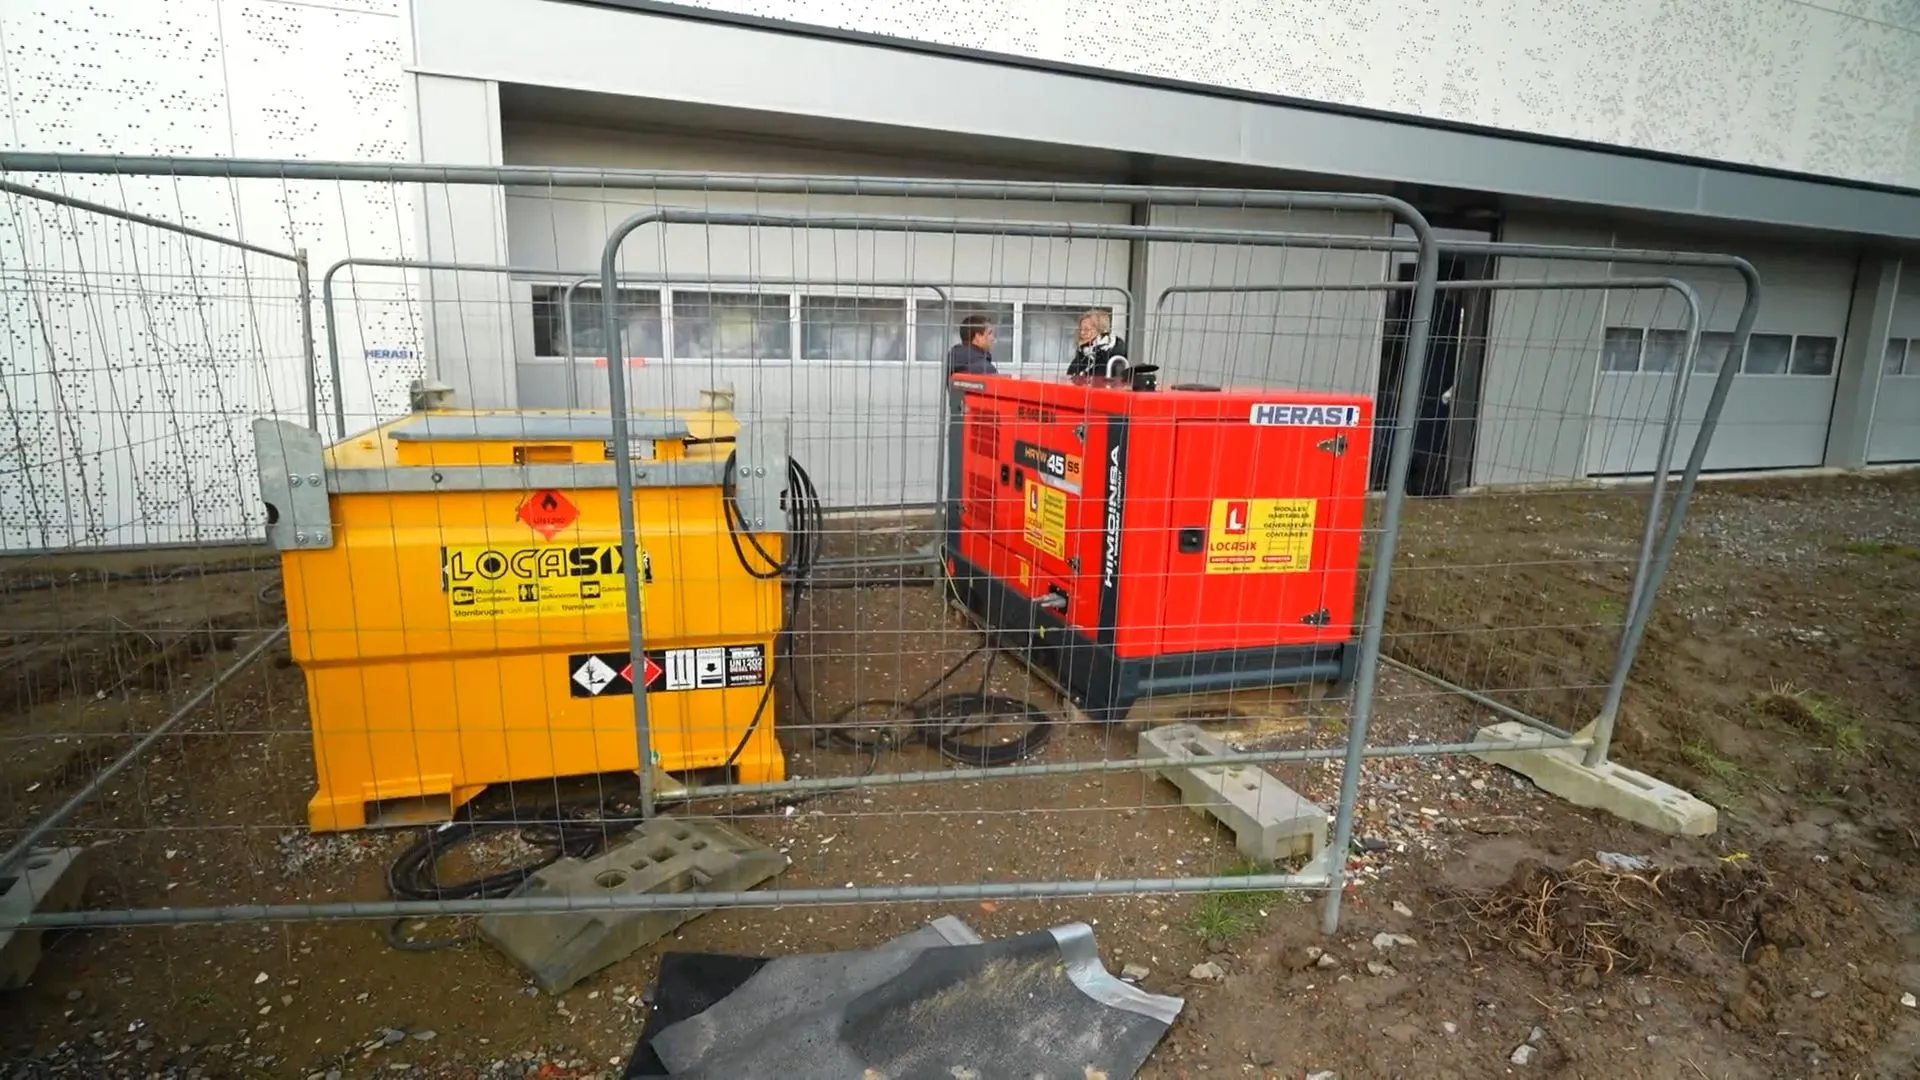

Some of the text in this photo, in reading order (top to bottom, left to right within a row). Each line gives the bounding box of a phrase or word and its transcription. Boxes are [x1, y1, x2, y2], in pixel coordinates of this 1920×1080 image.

[1047, 454, 1065, 475] 45
[1104, 445, 1120, 588] HIMOINSA
[1230, 508, 1244, 529] L
[1209, 542, 1257, 552] LOCASIX
[730, 658, 763, 667] UN1202
